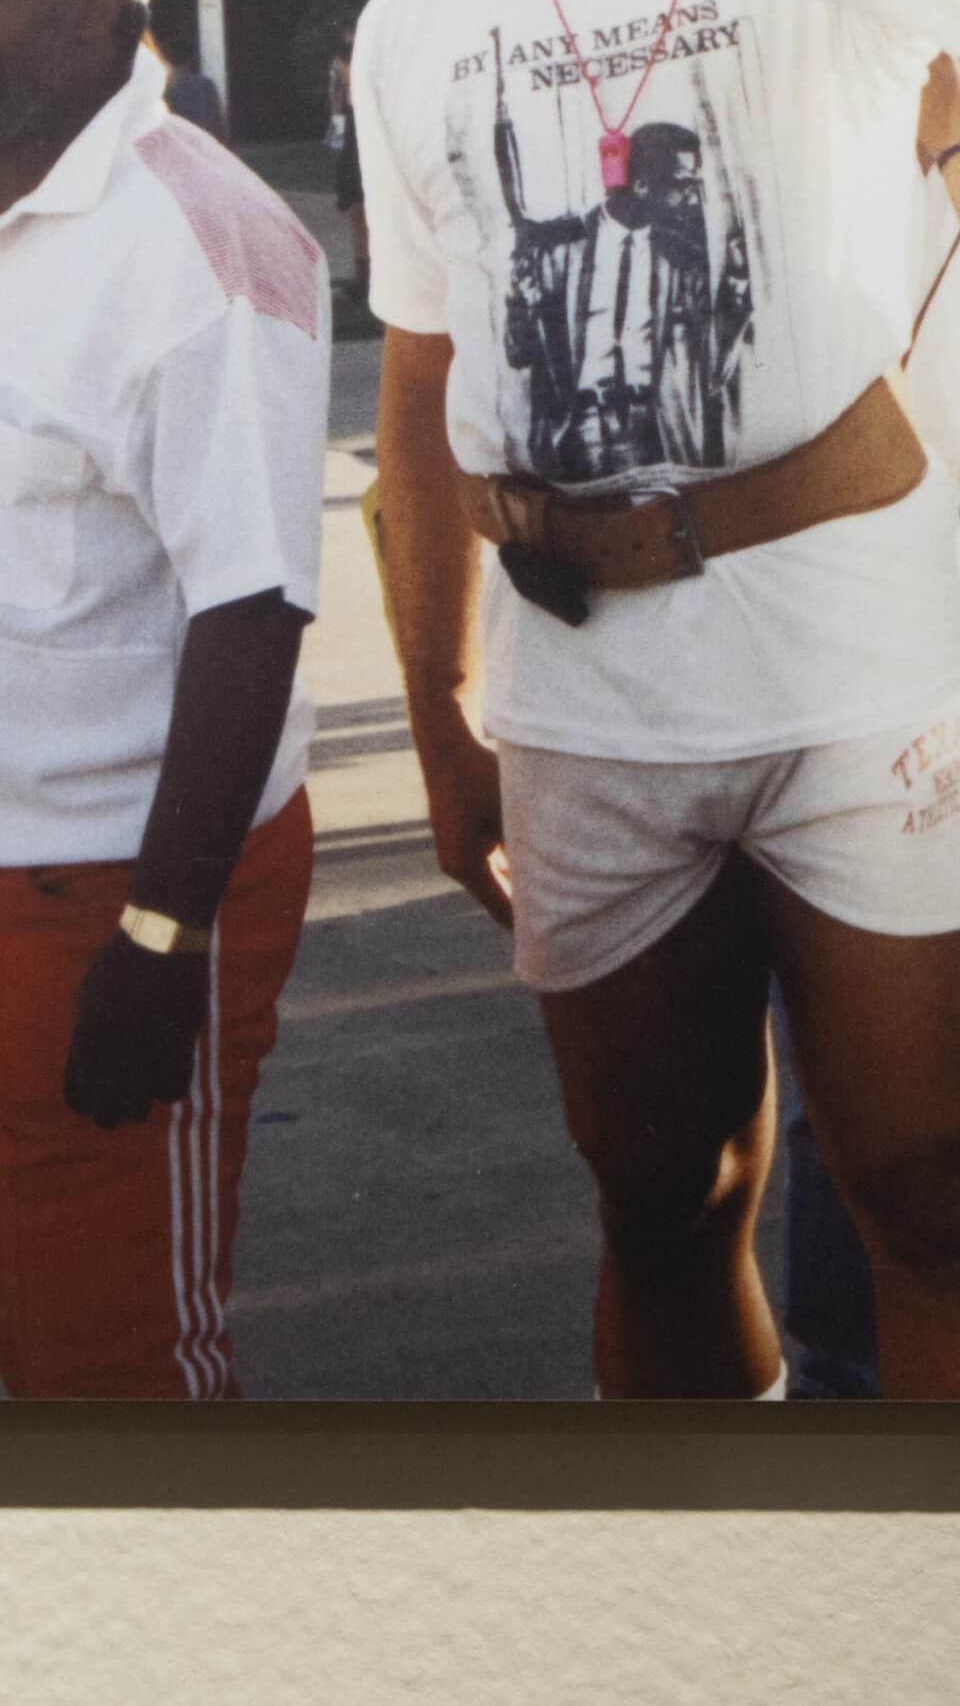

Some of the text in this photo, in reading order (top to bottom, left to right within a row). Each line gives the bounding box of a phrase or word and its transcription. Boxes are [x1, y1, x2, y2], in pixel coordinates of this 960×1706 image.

[450, 49, 490, 84] BY
[507, 32, 579, 67] ANY
[529, 20, 742, 91] NECESSARY
